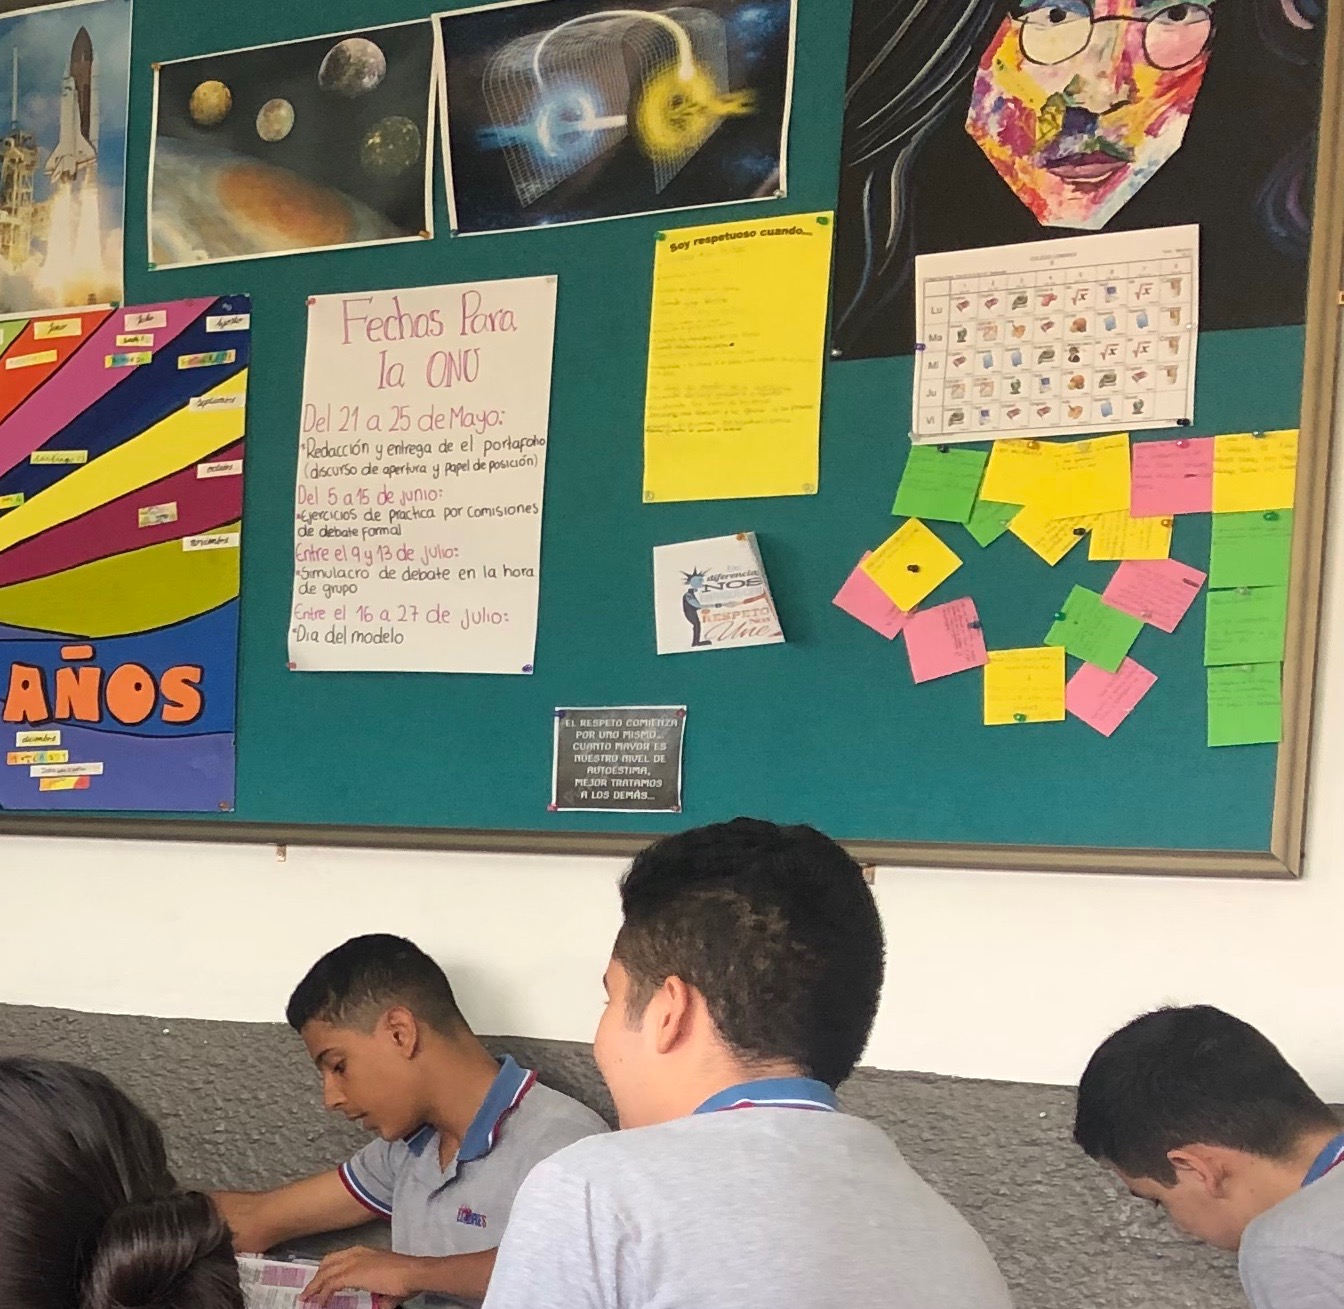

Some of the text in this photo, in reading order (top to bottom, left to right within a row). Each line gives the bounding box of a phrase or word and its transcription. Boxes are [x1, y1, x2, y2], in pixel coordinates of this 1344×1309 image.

[669, 240, 690, 253] Soy
[693, 230, 756, 245] respetuoso
[342, 290, 518, 345] Fechas Para
[378, 347, 481, 389] la ONU
[303, 403, 506, 434] Del 21 a 25 de Mayo:
[307, 437, 369, 460] Redacción
[376, 444, 384, 460] y
[387, 440, 432, 458] entrega
[439, 439, 454, 453] de
[461, 435, 474, 452] el
[362, 461, 379, 476] de
[383, 461, 427, 480] apertura
[433, 464, 440, 479] y
[445, 459, 470, 477] papel
[473, 457, 487, 471] de
[298, 484, 444, 508] Del 5 a 15 de junio:
[301, 508, 358, 525] Ejercicios
[364, 505, 382, 521] de
[443, 506, 463, 522] por
[297, 524, 315, 538] de
[318, 524, 359, 538] debate
[296, 542, 459, 567] Entre el 9 y 13 de julio:
[301, 563, 534, 581] Simulacro de debate en la hora
[298, 582, 358, 599] de grupo
[294, 603, 510, 630] Entre el 16 a 27 de julio:
[324, 624, 347, 645] del
[351, 627, 404, 644] modelo
[2, 643, 205, 727] AÑOS
[565, 719, 678, 727] EL RESPETO COMIENZA
[576, 731, 595, 739] POR
[599, 731, 619, 739] UNO
[573, 742, 666, 751] CUANTO MAYOR ES
[574, 754, 666, 763] NUESTRO NIVEL DE
[575, 779, 662, 788] MEJOR TRATAMOS
